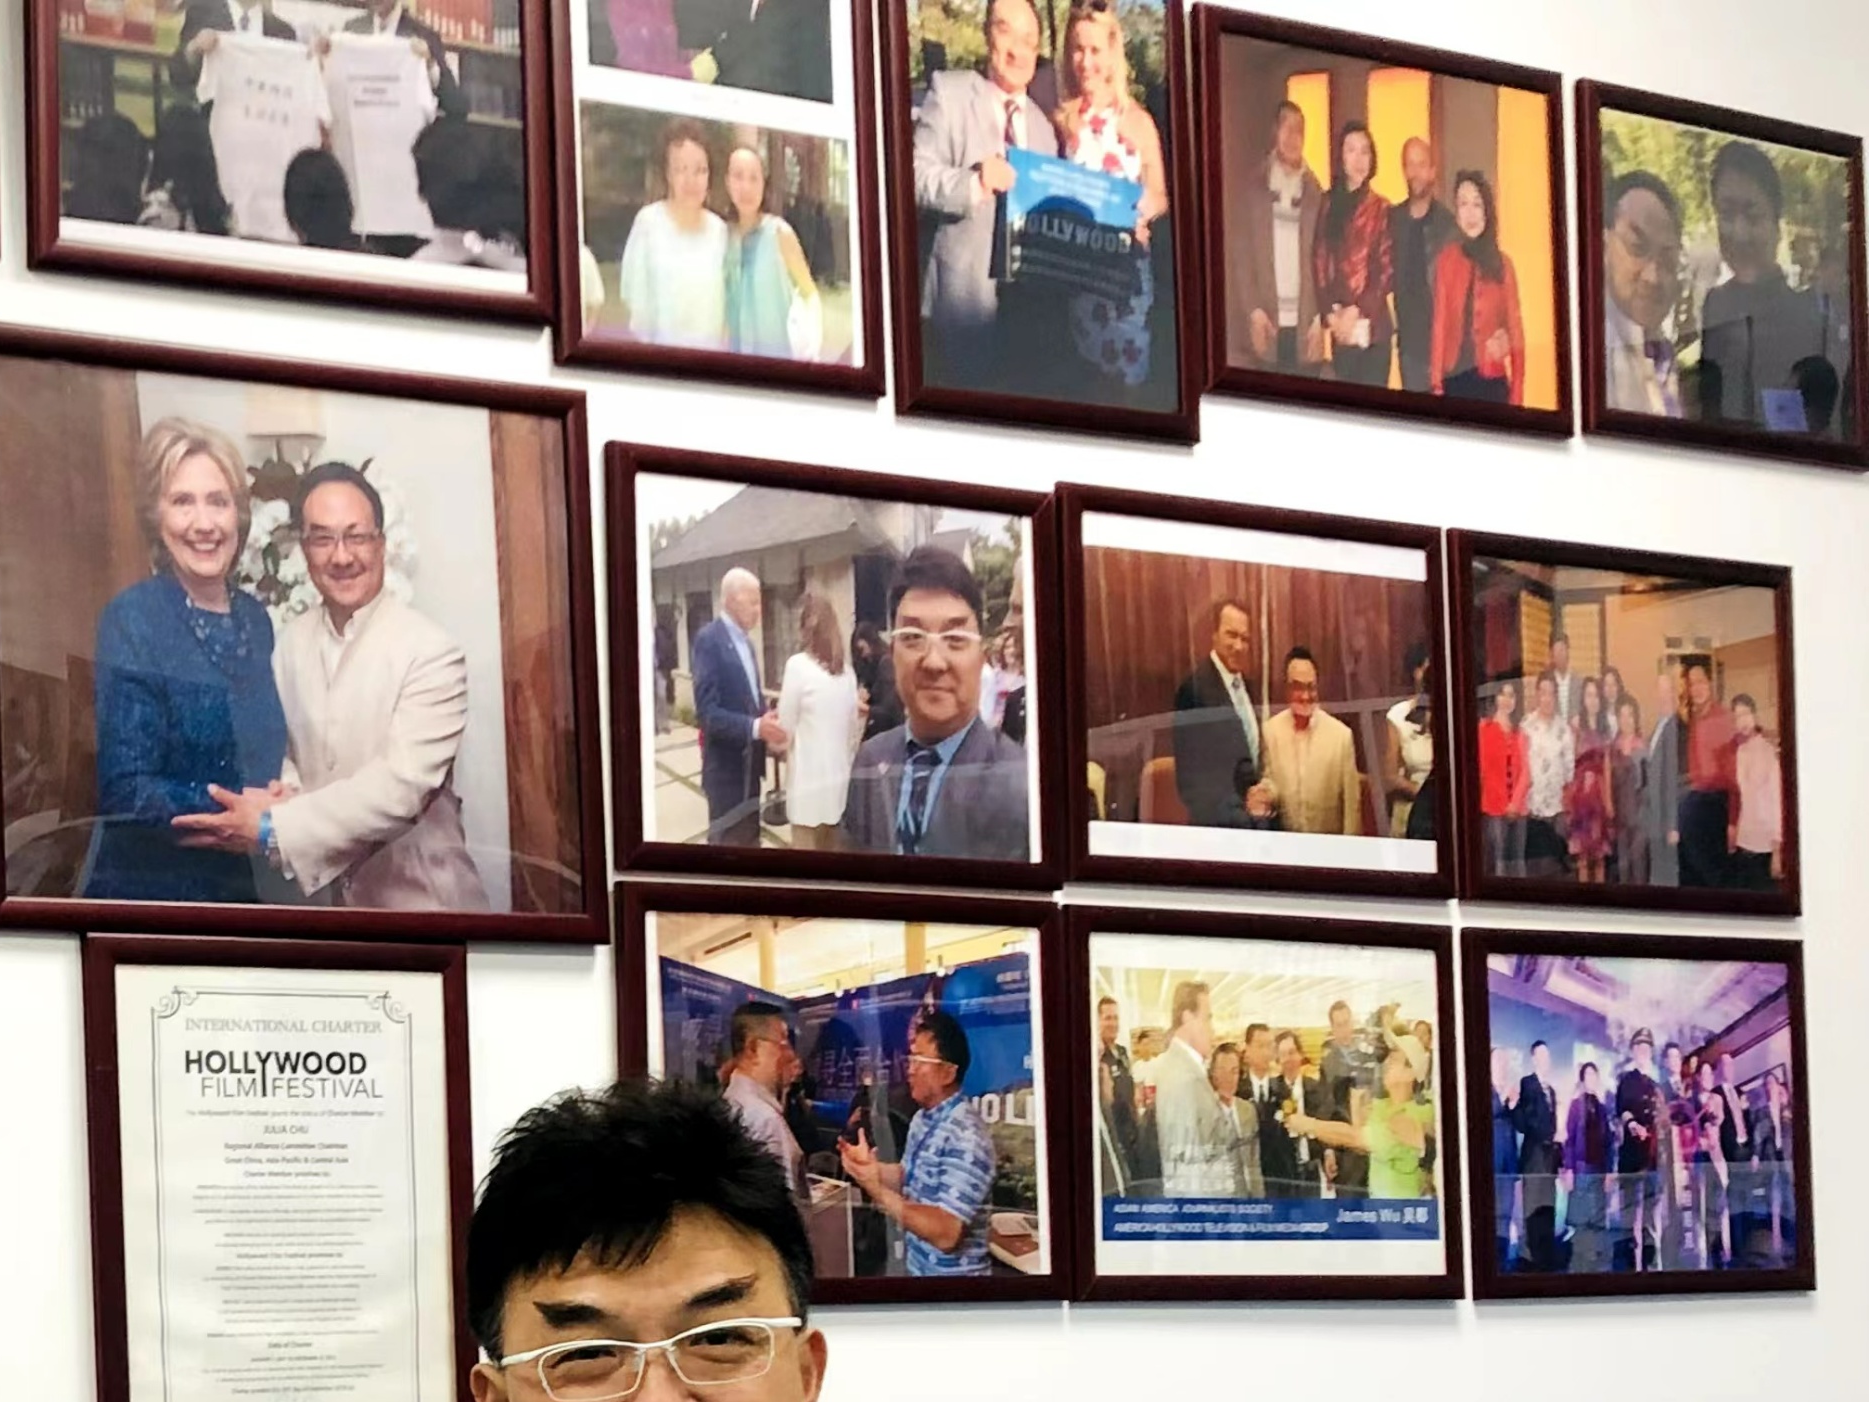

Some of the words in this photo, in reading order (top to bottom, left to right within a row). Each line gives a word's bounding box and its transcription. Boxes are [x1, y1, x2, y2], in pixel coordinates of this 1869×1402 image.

[185, 1018, 308, 1033] INTERNATIONAL
[312, 1020, 382, 1034] CHARTER
[185, 1050, 367, 1098] HOLLYWOOD
[201, 1077, 258, 1098] FILM
[272, 1077, 384, 1099] FESTIVAL
[1336, 1208, 1378, 1223] James
